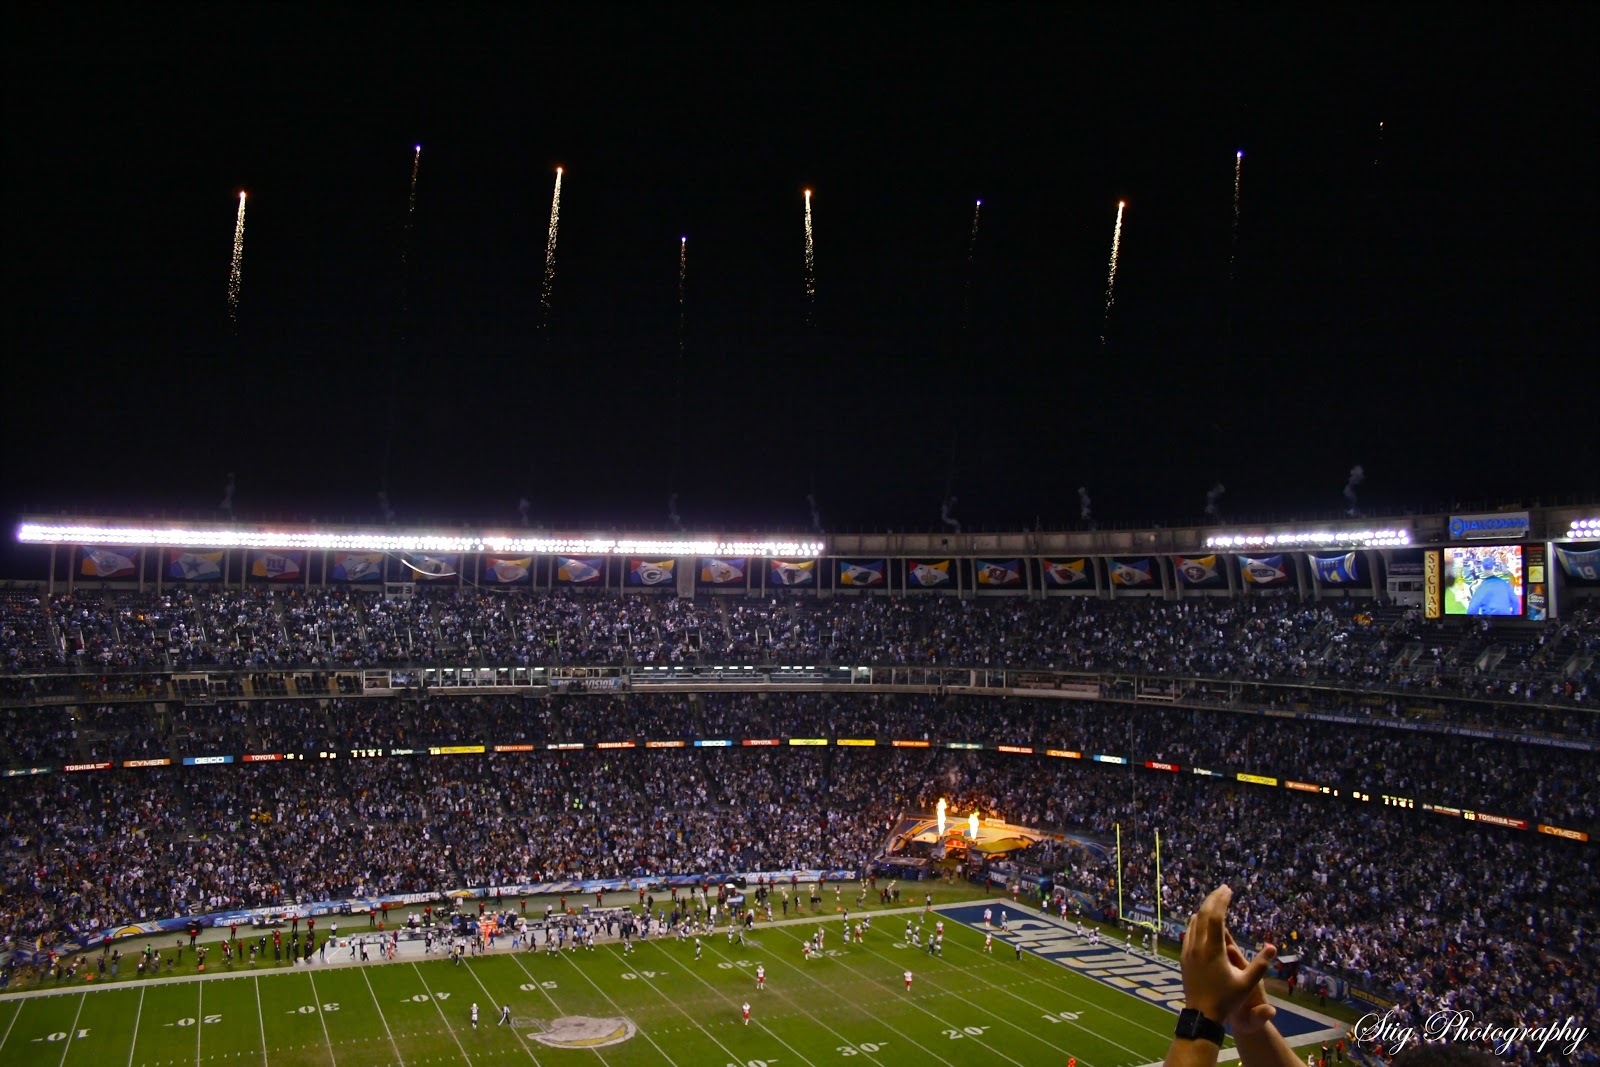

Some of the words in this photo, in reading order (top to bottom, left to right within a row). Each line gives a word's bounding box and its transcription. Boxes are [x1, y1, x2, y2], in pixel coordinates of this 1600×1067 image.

[1450, 518, 1528, 538] QUALCOMM
[1428, 553, 1437, 617] SYCUAN
[194, 756, 225, 764] GEICO
[65, 764, 96, 772] TOSHIBA
[1478, 813, 1508, 824] TOSHIBA
[1544, 826, 1581, 839] CYMER
[1041, 1010, 1079, 1024] 10
[942, 1025, 986, 1041] 20
[836, 1042, 881, 1058] 30
